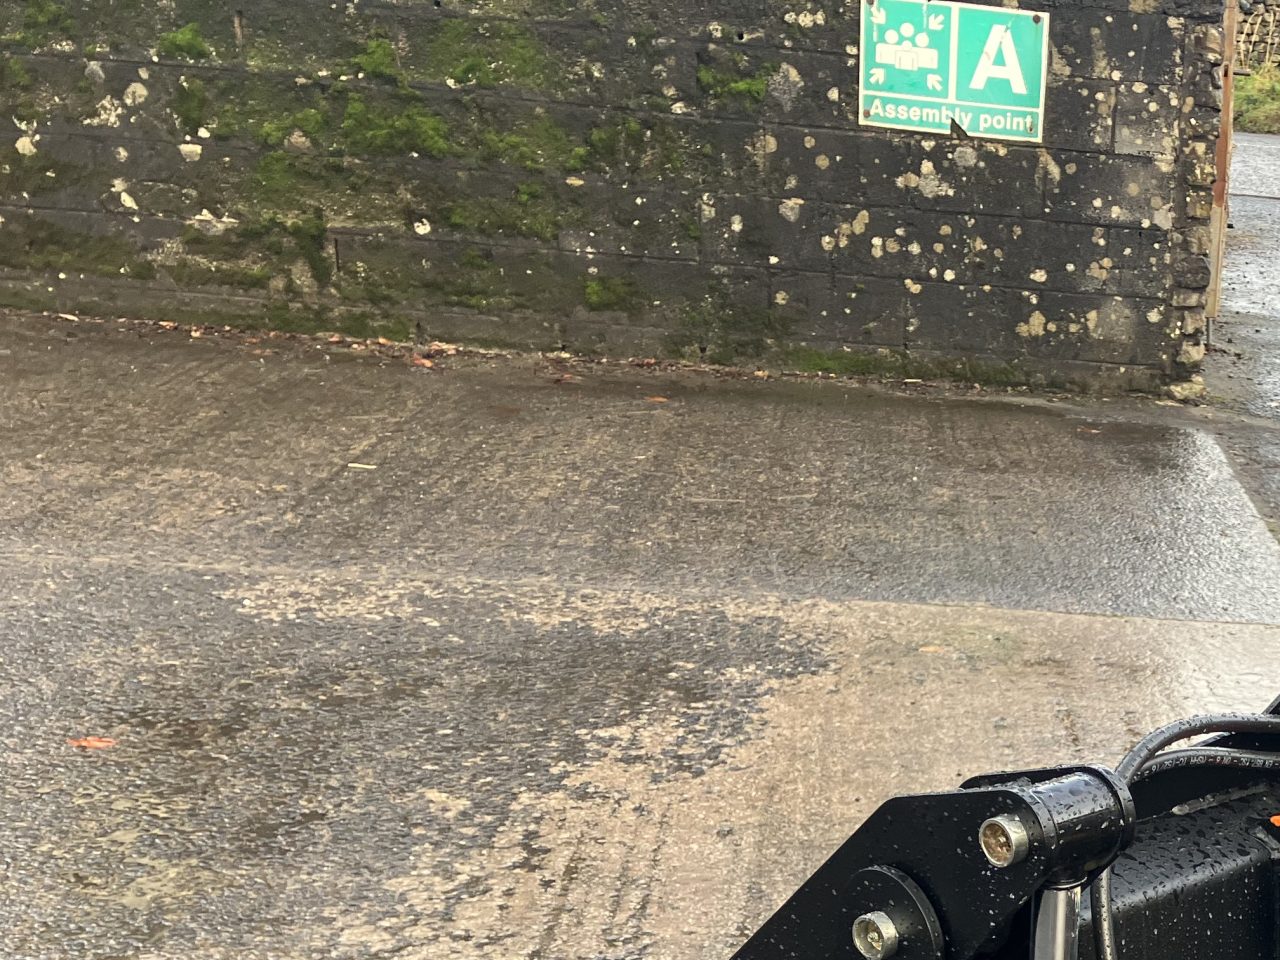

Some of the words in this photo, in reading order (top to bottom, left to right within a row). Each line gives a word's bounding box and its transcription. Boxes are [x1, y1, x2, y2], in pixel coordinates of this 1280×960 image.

[968, 24, 1028, 95] A
[869, 98, 972, 129] Assembly
[979, 112, 1034, 133] point
